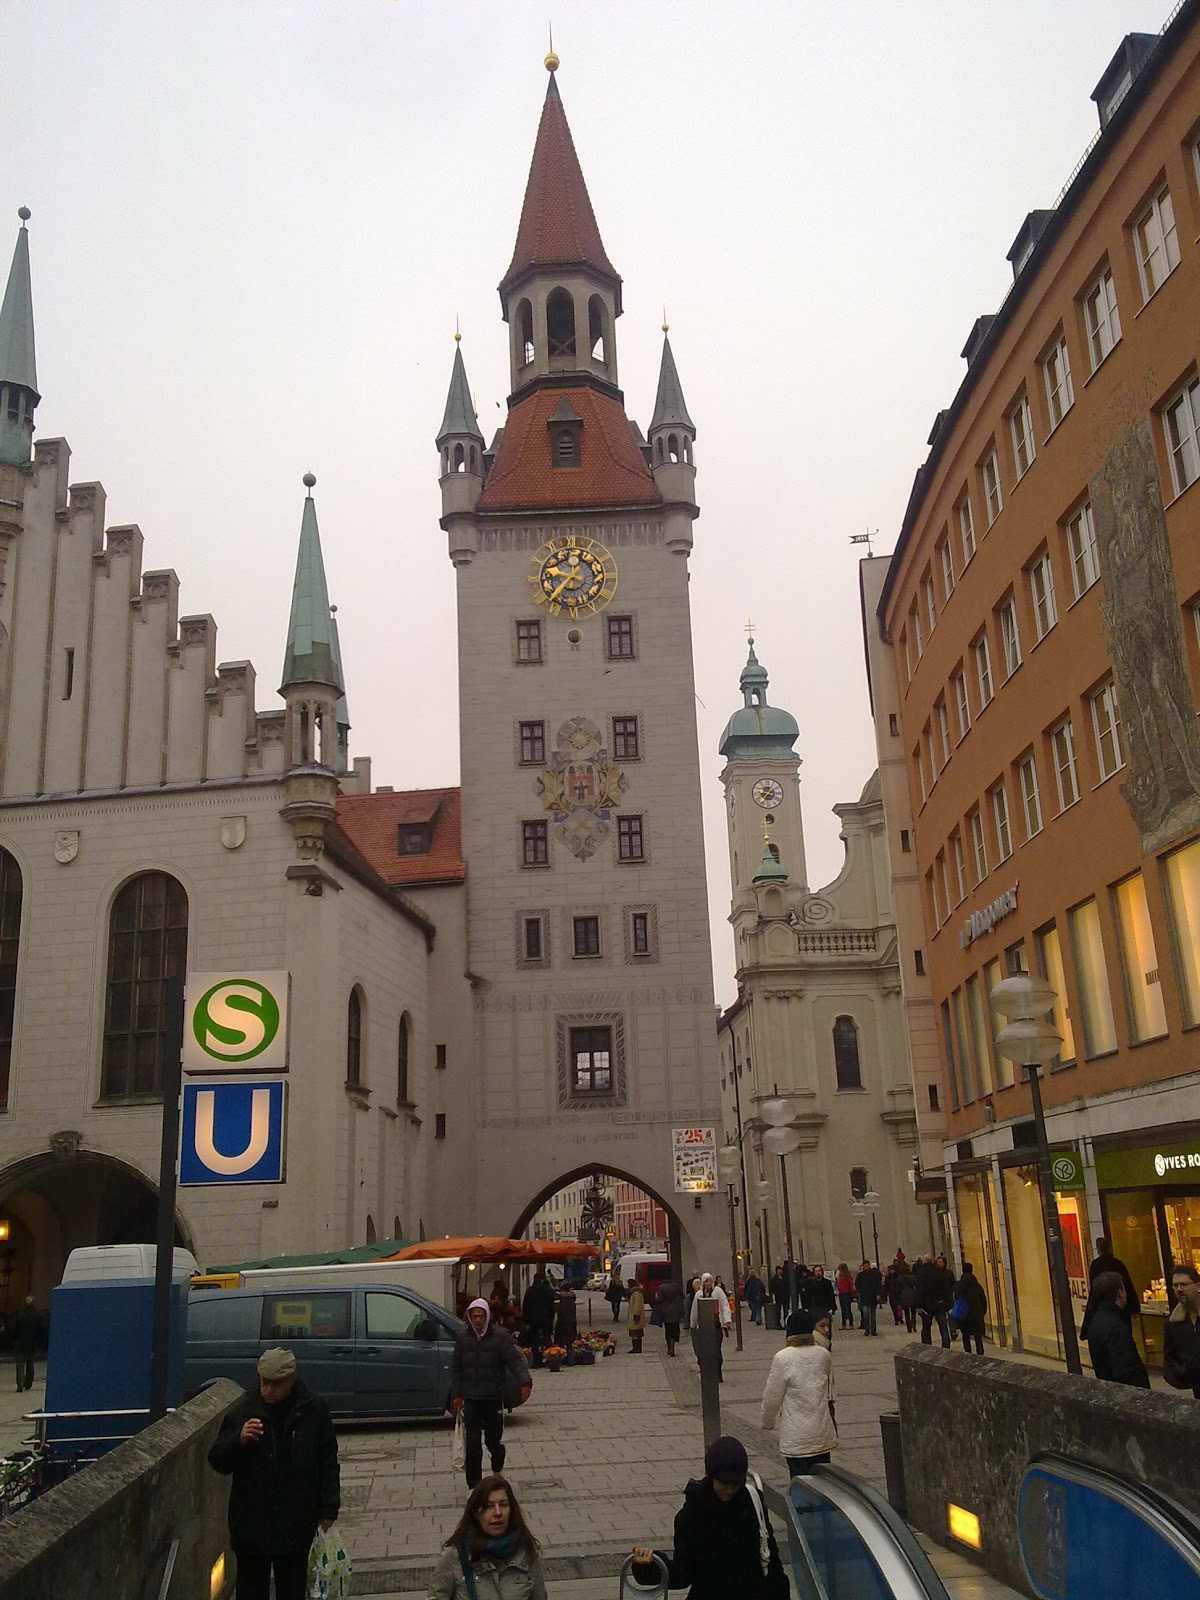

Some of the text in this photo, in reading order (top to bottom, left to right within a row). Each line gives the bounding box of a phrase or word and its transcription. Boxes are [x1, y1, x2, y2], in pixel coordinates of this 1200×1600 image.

[206, 984, 265, 1056] S
[195, 1089, 271, 1175] U
[1164, 1155, 1187, 1170] YVES
[1070, 1280, 1088, 1300] ALE
